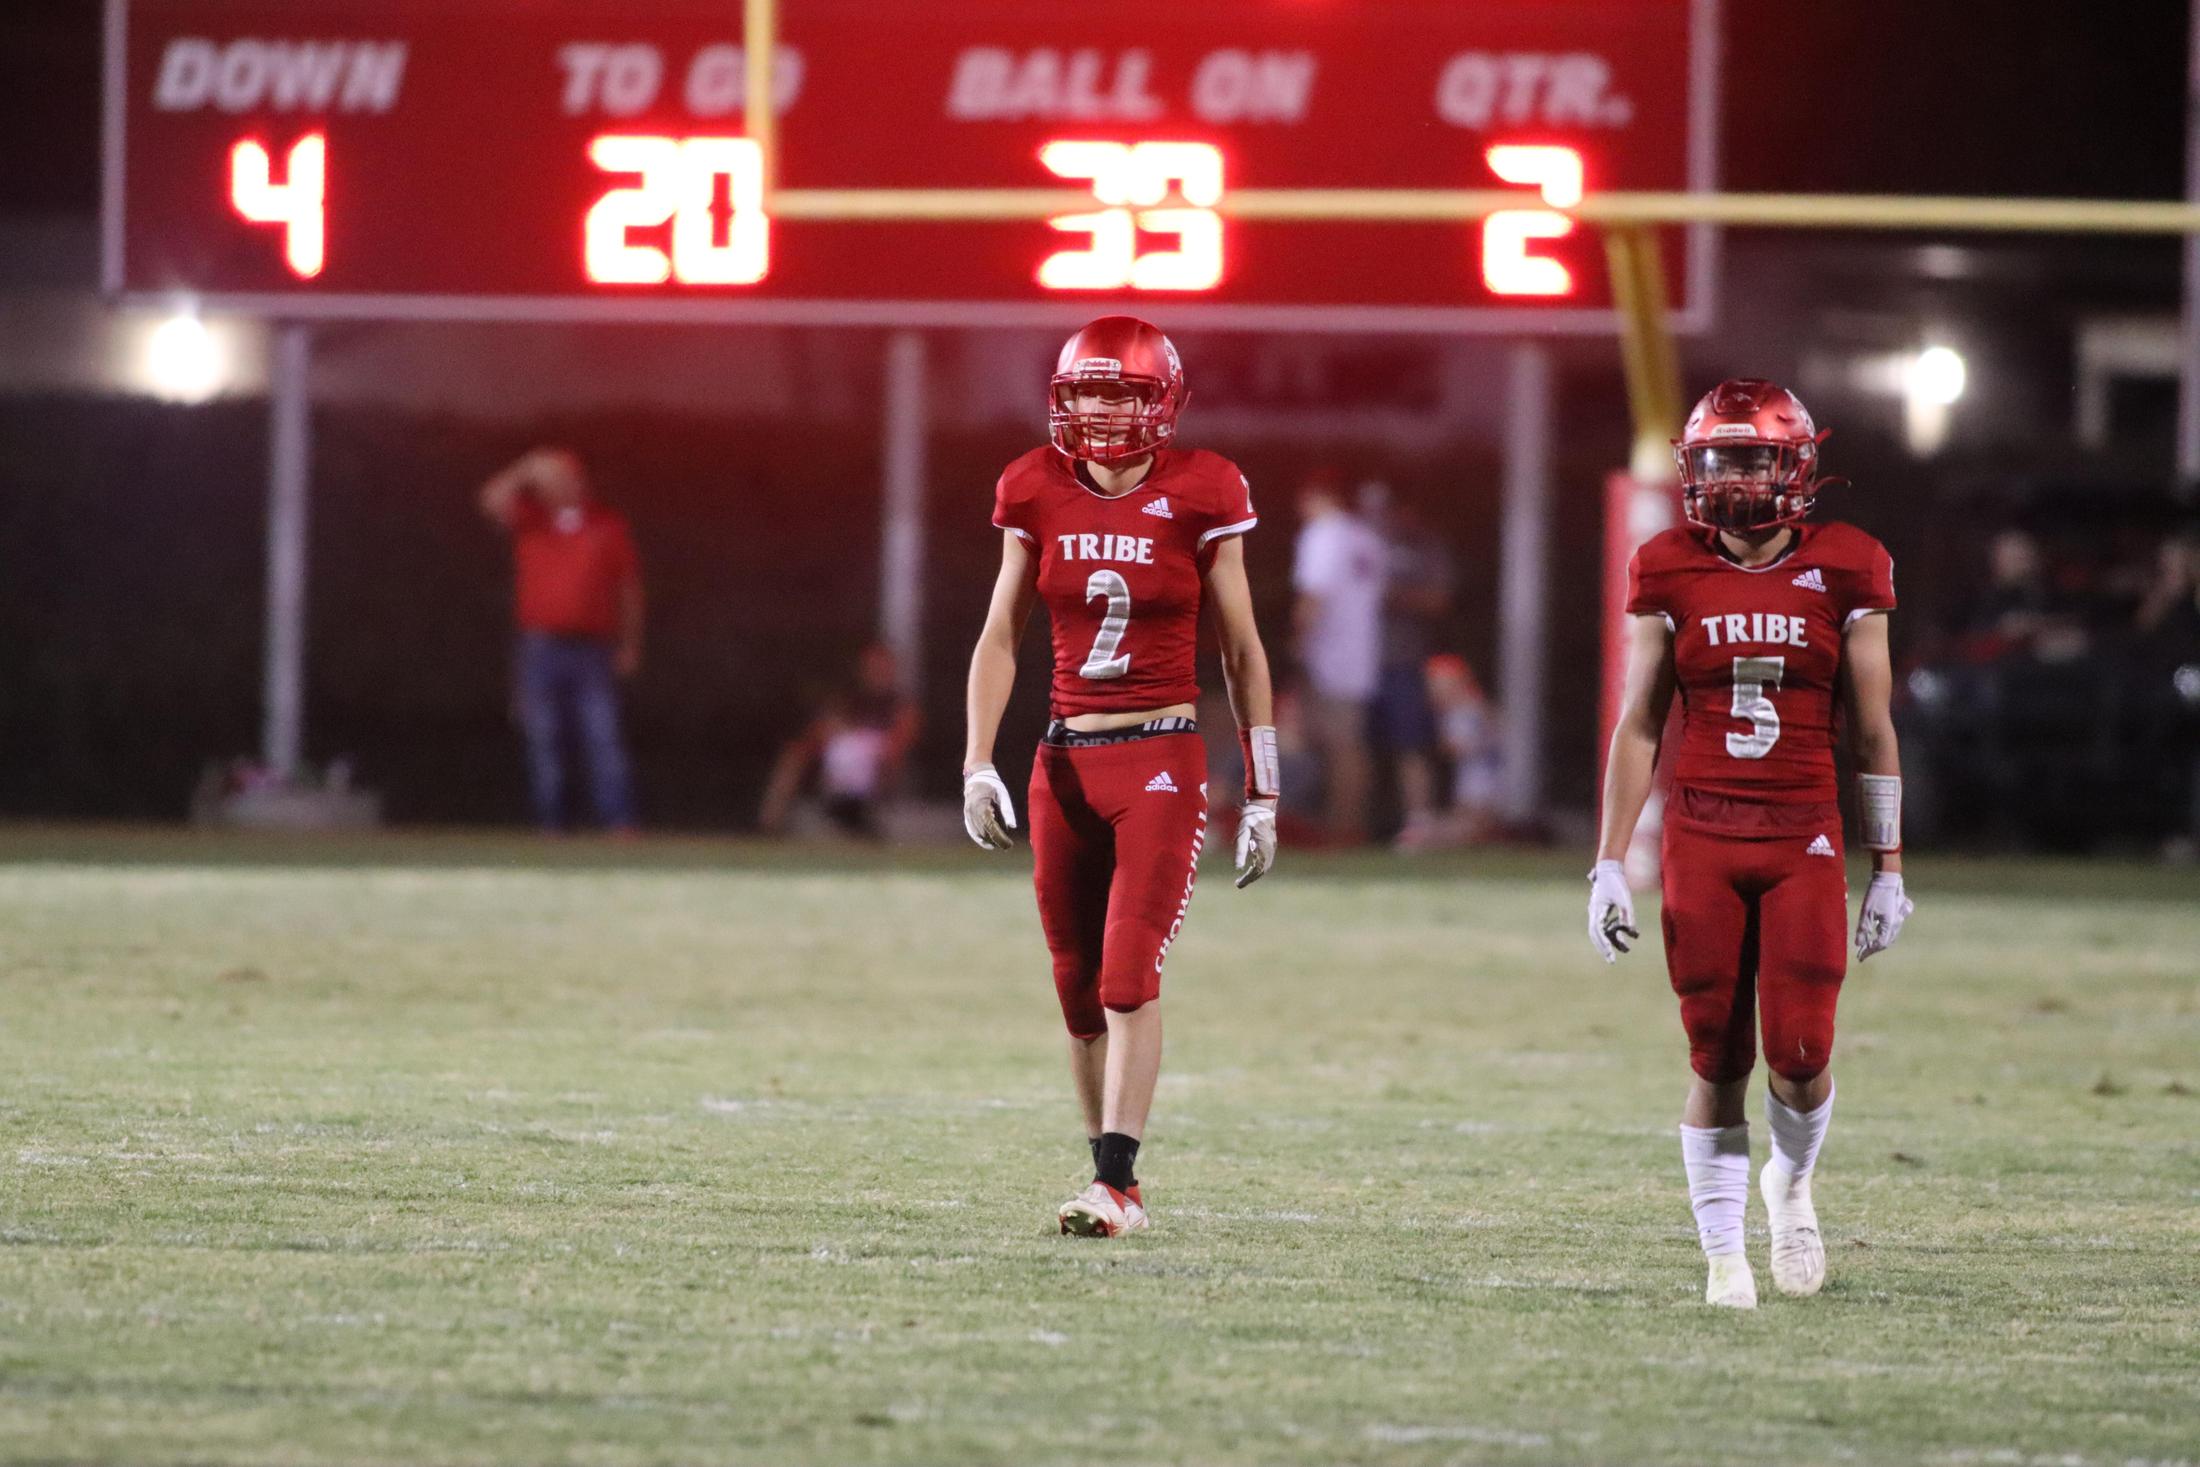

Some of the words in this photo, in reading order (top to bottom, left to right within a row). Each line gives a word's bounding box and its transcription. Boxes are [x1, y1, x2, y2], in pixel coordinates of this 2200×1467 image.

[153, 39, 407, 114] DOWN
[557, 43, 663, 116] TO
[946, 47, 1162, 121] BALL
[1192, 50, 1316, 123] ON
[1436, 53, 1636, 128] QTR.
[230, 133, 326, 279] 4
[585, 134, 770, 285] 20
[1482, 144, 1585, 296] 2
[1058, 534, 1154, 565] TRIBE
[1141, 506, 1173, 519] adidas
[1791, 578, 1827, 593] adidas
[1079, 569, 1131, 679] 2
[1701, 614, 1809, 648] TRIBE
[1725, 656, 1785, 759] 5
[1145, 783, 1178, 793] adidas
